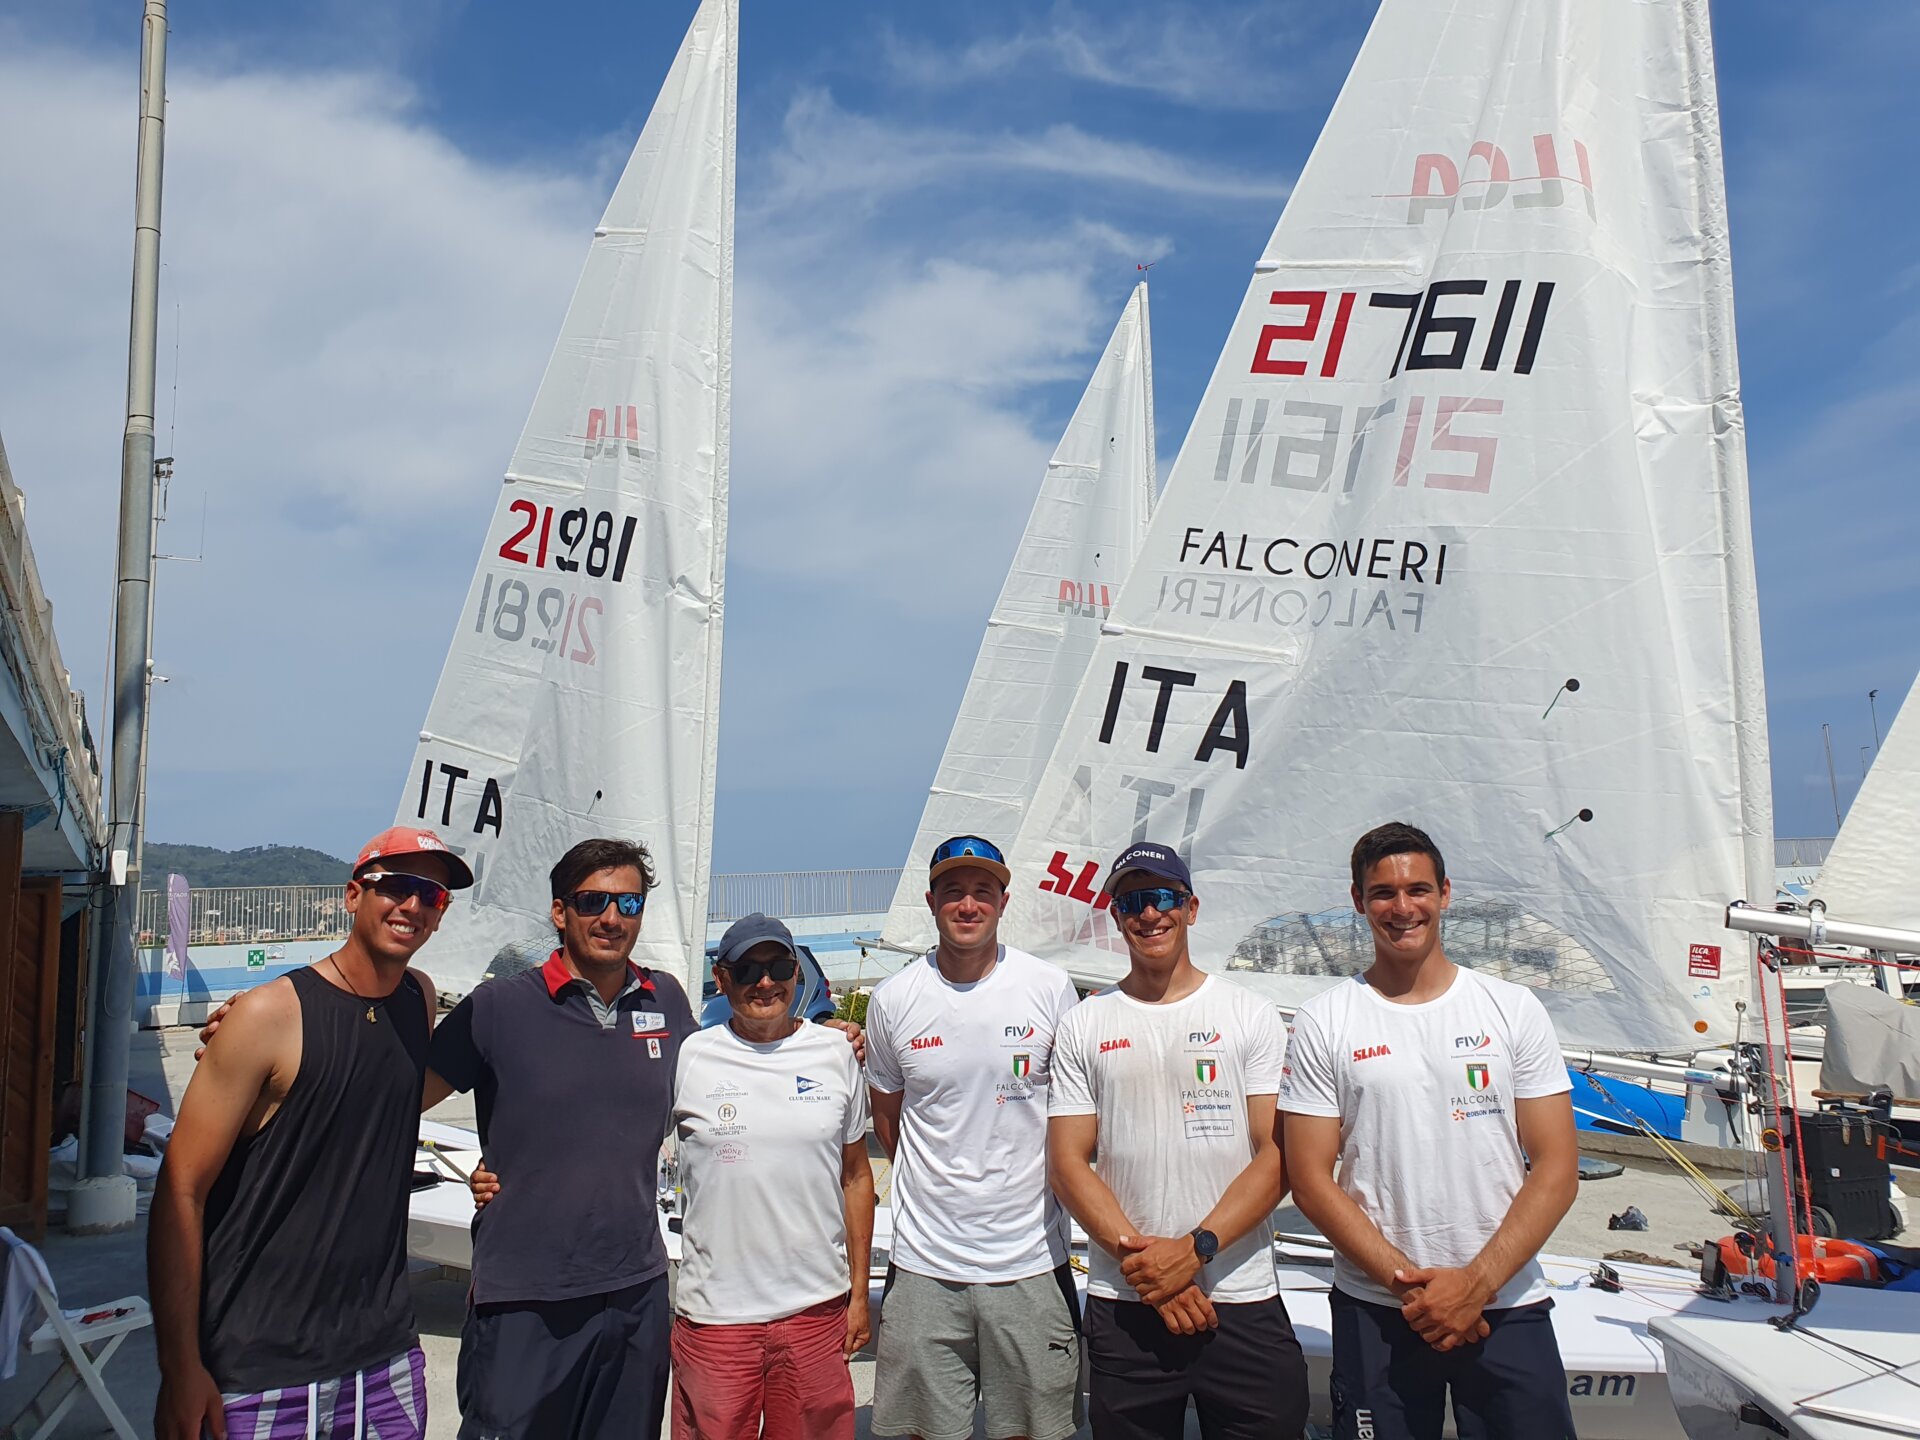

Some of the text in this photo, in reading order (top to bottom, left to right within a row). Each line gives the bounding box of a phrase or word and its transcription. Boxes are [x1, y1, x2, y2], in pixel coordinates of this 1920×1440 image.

[1250, 279, 1556, 379] 217611
[1179, 527, 1447, 585] FALCONERI
[1098, 661, 1250, 770] ITA
[417, 759, 503, 839] ITA
[1115, 850, 1166, 870] FALCONERI
[1004, 1026, 1026, 1037] FIV
[1189, 1032, 1211, 1043] FIV
[1454, 1034, 1481, 1048] FIV
[910, 1035, 943, 1050] SLAM
[1099, 1038, 1131, 1054] SLAM
[1353, 1044, 1391, 1062] SLAM
[715, 1148, 742, 1157] LIMONE
[1569, 1374, 1636, 1397] am
[1356, 1408, 1375, 1440] am
